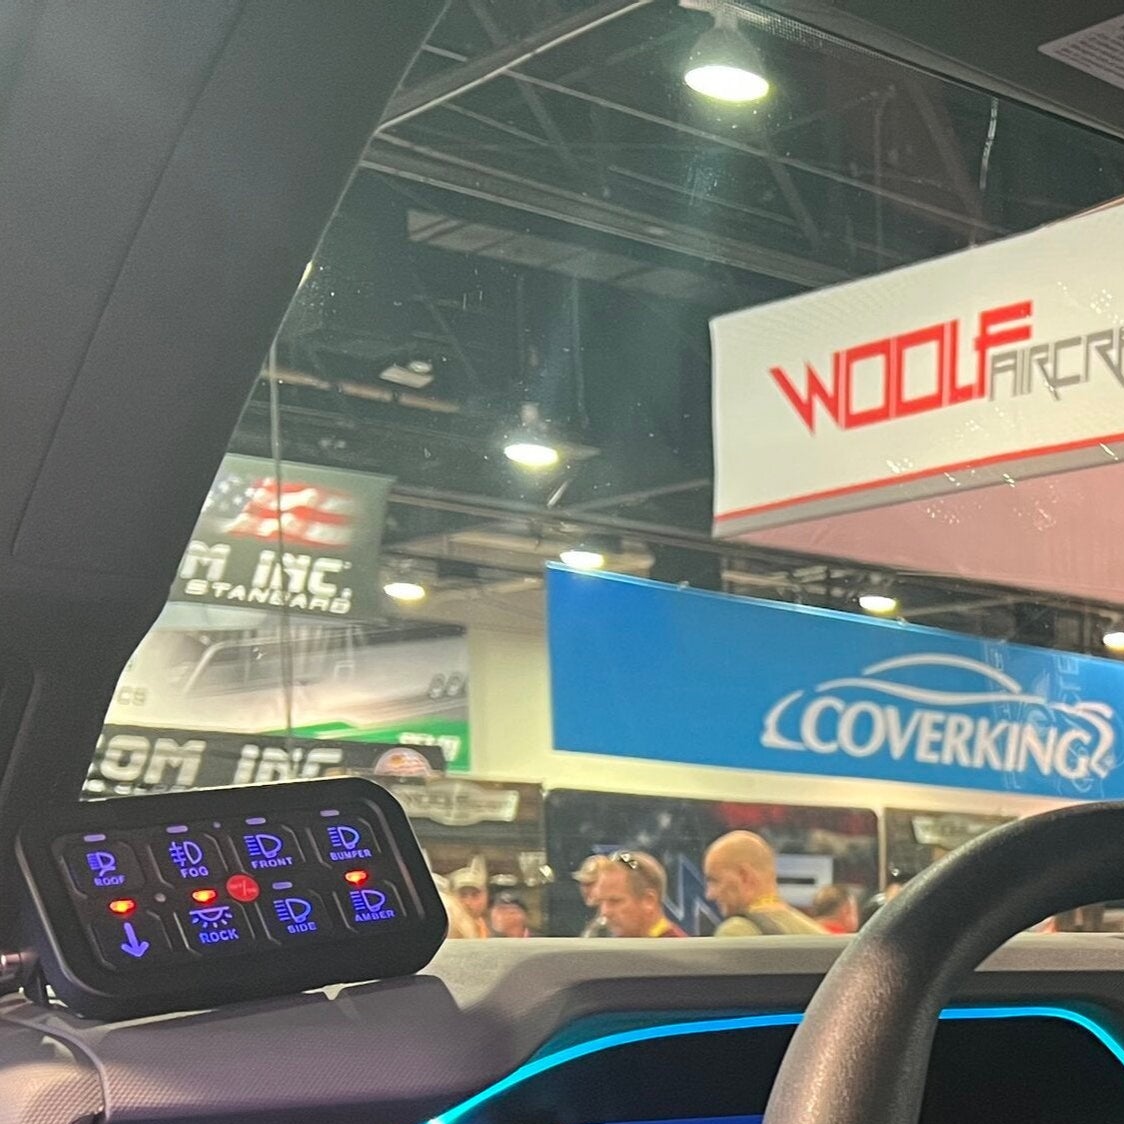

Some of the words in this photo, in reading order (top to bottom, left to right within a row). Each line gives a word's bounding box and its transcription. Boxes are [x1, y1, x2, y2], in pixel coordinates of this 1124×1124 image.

[770, 300, 1033, 436] WOOLF
[185, 580, 352, 614] STANDARD
[801, 696, 1090, 779] COVERKING
[329, 848, 373, 862] BUMPER
[251, 856, 293, 870] FRONT
[180, 866, 209, 879] FOG
[94, 875, 125, 887] ROOF
[354, 909, 396, 922] AMBER
[287, 921, 317, 934] SIDE
[199, 928, 239, 944] ROCK
